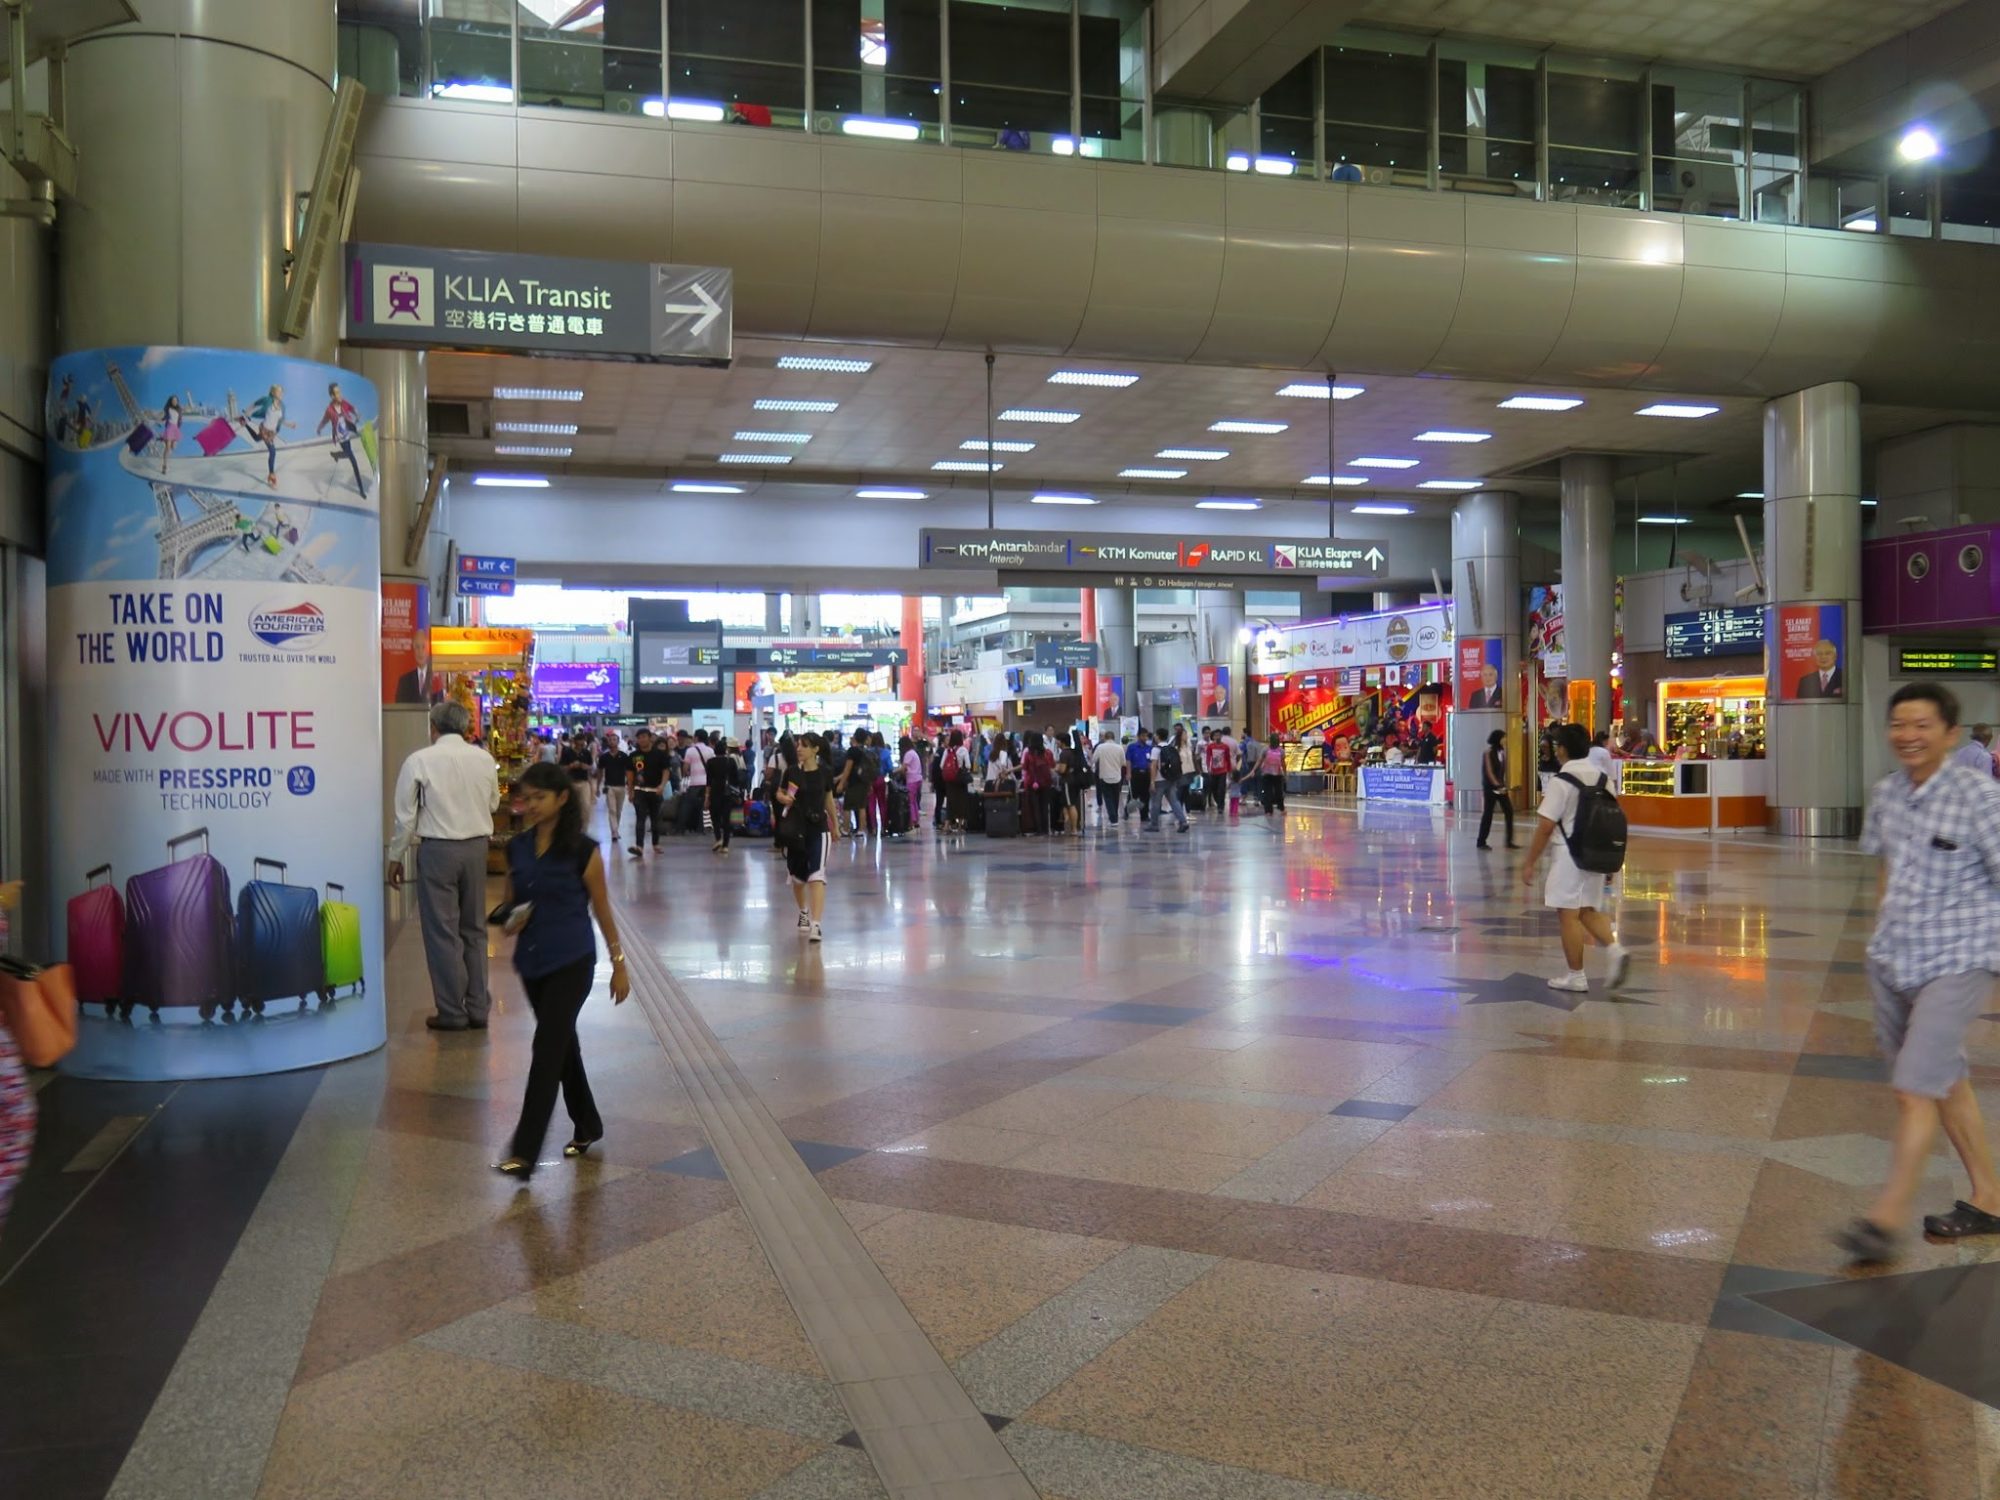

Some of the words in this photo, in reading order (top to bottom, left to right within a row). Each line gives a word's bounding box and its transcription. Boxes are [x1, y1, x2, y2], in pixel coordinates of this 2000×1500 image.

[445, 274, 515, 304] KLIA
[519, 280, 612, 310] Transit
[445, 309, 604, 336] 空港行き普通電車
[959, 544, 988, 557] KTM
[989, 539, 1066, 553] Antarabandar
[1098, 546, 1126, 560] KTM
[1129, 547, 1178, 561] Komuter
[1211, 549, 1246, 562] RAPID
[1248, 550, 1263, 562] KL
[1297, 546, 1323, 558] KLIA
[1325, 547, 1362, 561] Ekspres
[477, 561, 495, 571] LRT
[989, 554, 1024, 566] Intercity
[475, 581, 500, 591] TIKET
[109, 593, 173, 625] TAKE
[185, 593, 223, 624] ON
[254, 614, 325, 624] AMERICAN
[253, 622, 326, 632] TOURISTER
[77, 632, 115, 665] THE
[126, 631, 224, 664] WORLD
[239, 653, 271, 663] TRUSTED
[273, 653, 285, 663] ALL
[287, 654, 304, 663] OVER
[305, 654, 317, 664] THE
[318, 655, 336, 664] WORLD
[92, 711, 315, 752] VIVOLITE
[93, 769, 122, 784] MADE
[124, 768, 154, 783] WITH
[160, 791, 272, 811] TECHNOLOGY
